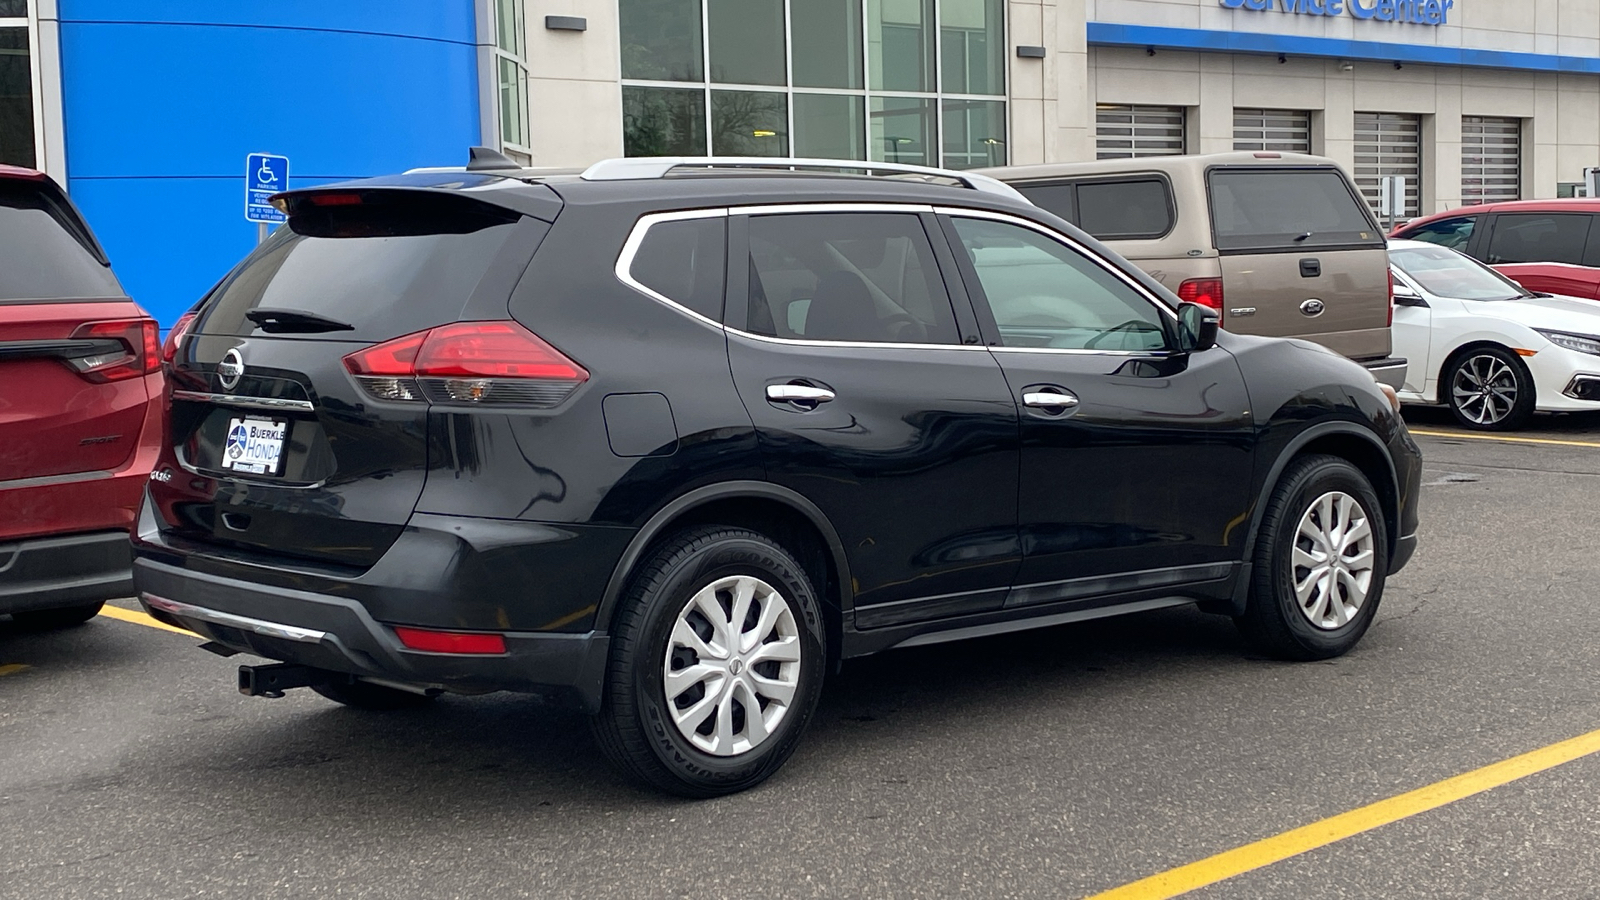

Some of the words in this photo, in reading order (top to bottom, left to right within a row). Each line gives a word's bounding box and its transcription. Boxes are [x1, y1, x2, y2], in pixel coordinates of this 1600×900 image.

[1346, 0, 1454, 25] Center
[250, 426, 284, 441] BUERKLE
[246, 439, 281, 460] HONDA
[717, 551, 816, 626] GOODYEAR
